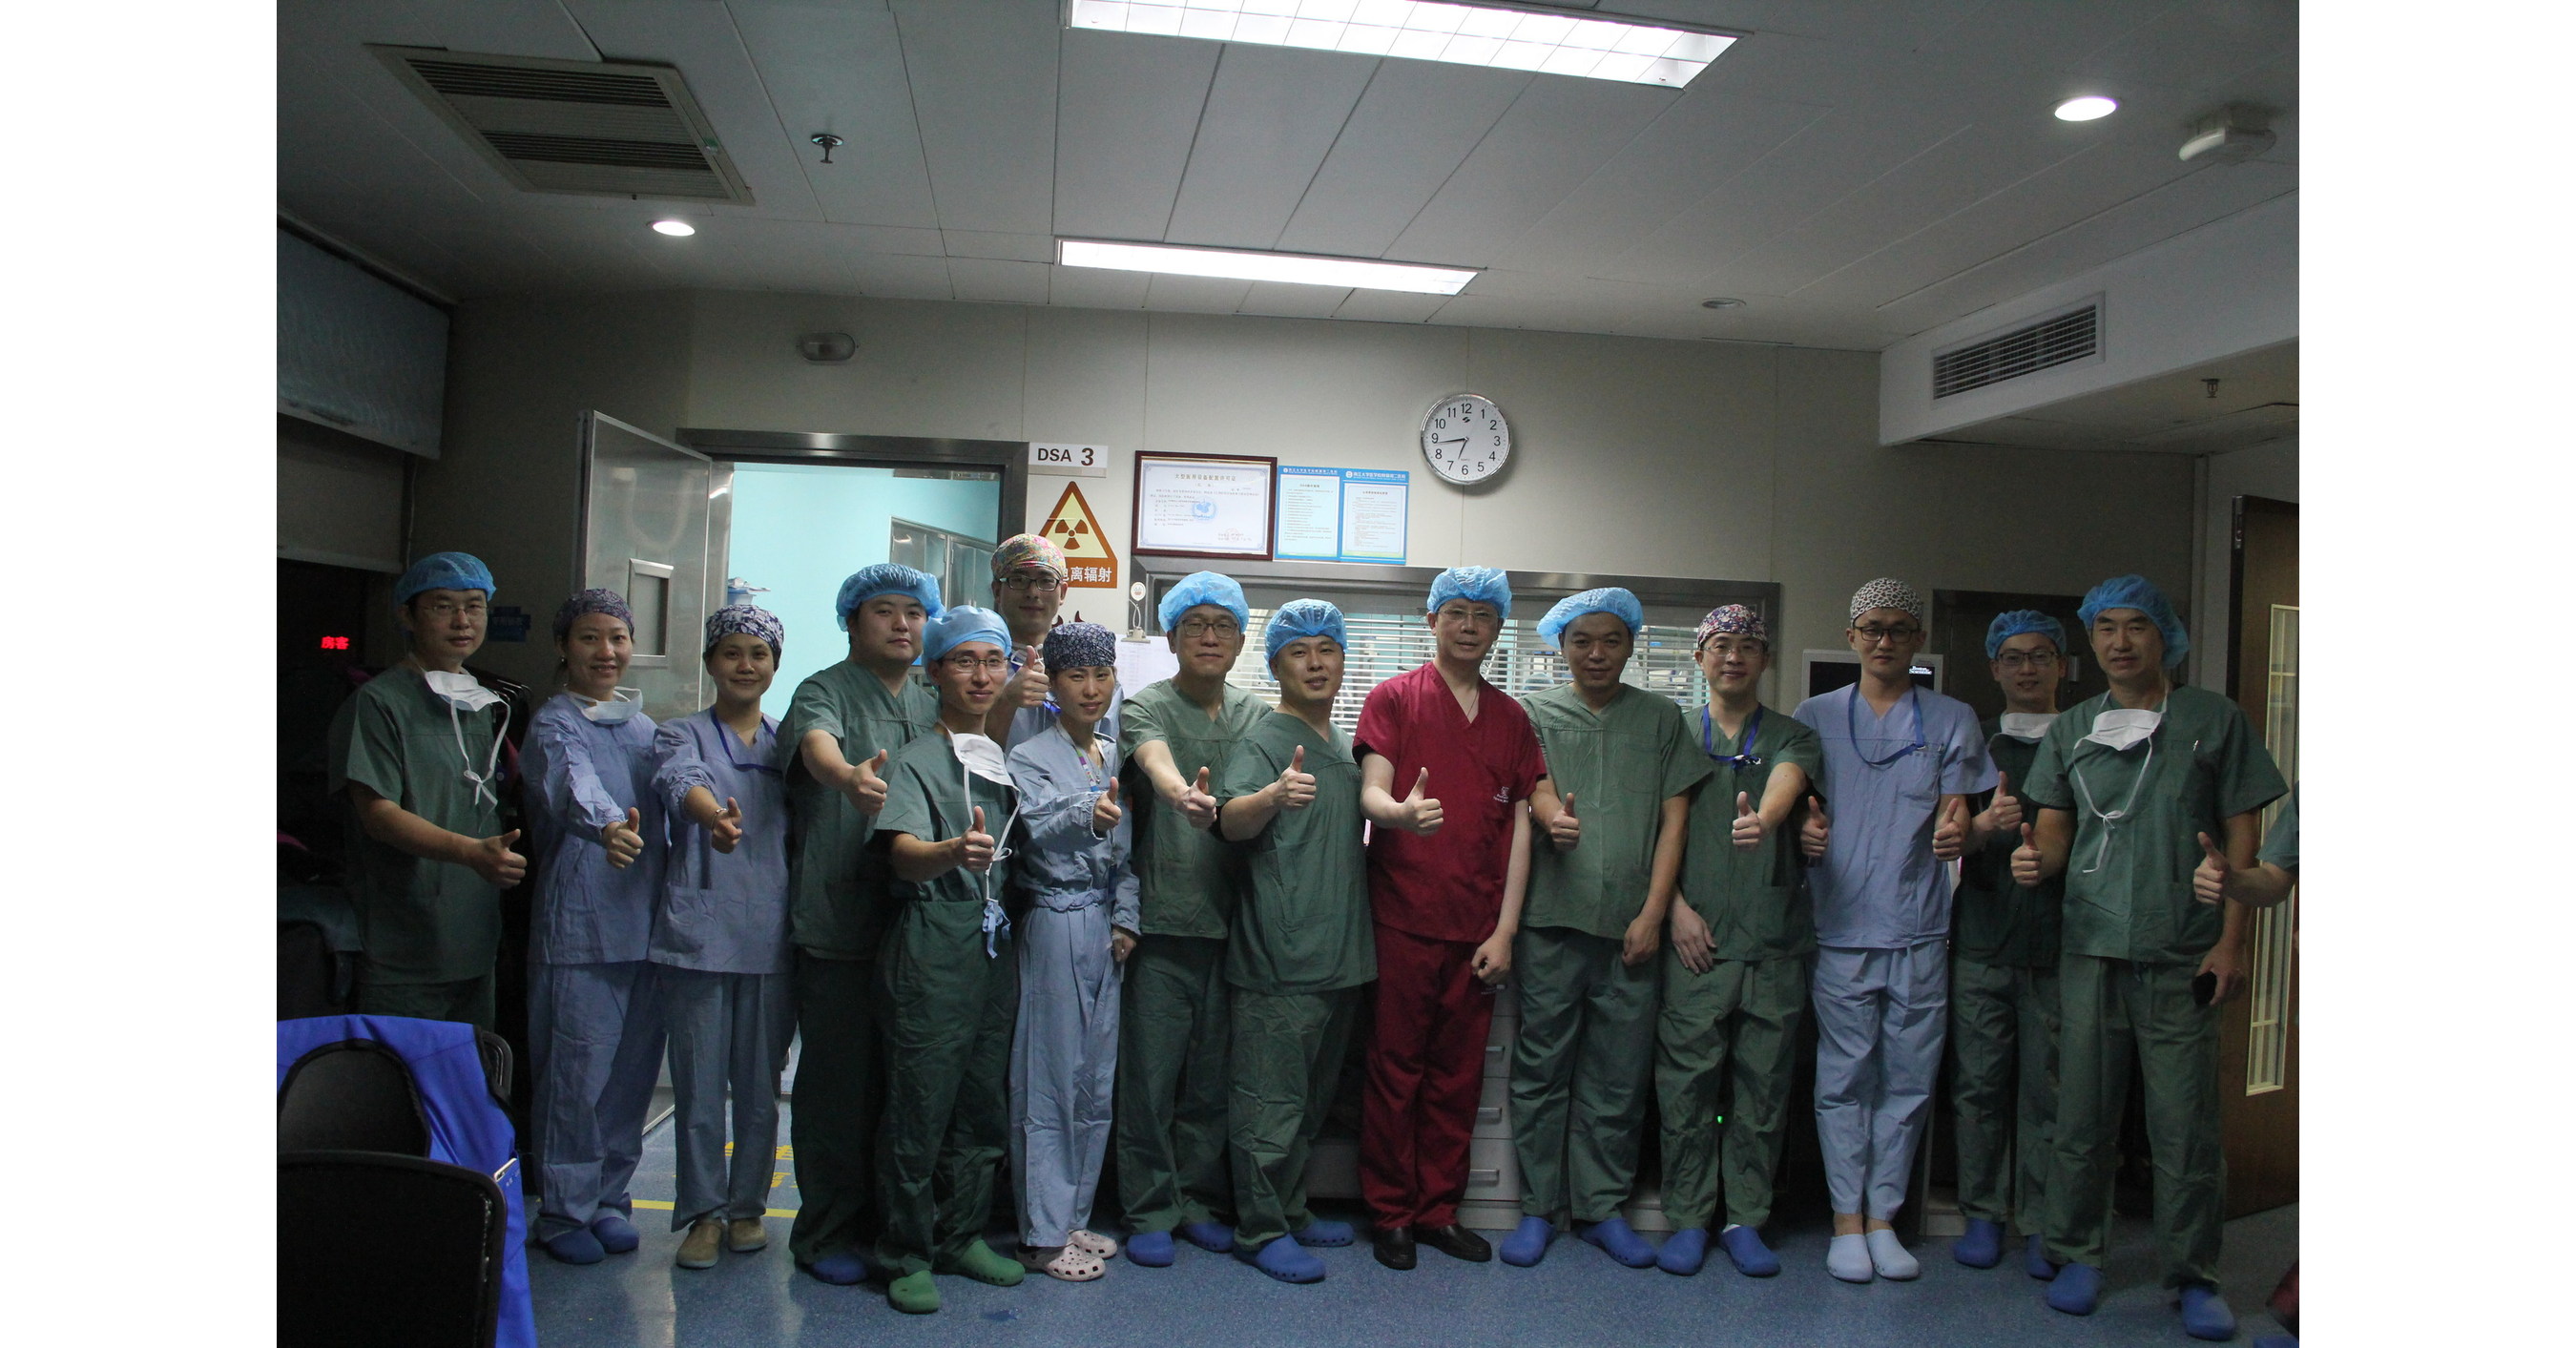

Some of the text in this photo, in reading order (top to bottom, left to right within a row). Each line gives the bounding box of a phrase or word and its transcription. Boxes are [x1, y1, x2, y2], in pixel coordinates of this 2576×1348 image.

[1447, 407, 1456, 418] 11
[1461, 404, 1472, 414] 12
[1435, 419, 1446, 429] 10
[1489, 420, 1497, 430] 2
[1431, 432, 1439, 444] 9
[1493, 436, 1501, 446] 3
[1037, 447, 1094, 467] DSA 3
[1435, 448, 1443, 459] 8
[1488, 451, 1496, 461] 4
[1447, 461, 1454, 470] 7
[1461, 465, 1469, 475] 6
[1477, 462, 1485, 472] 5
